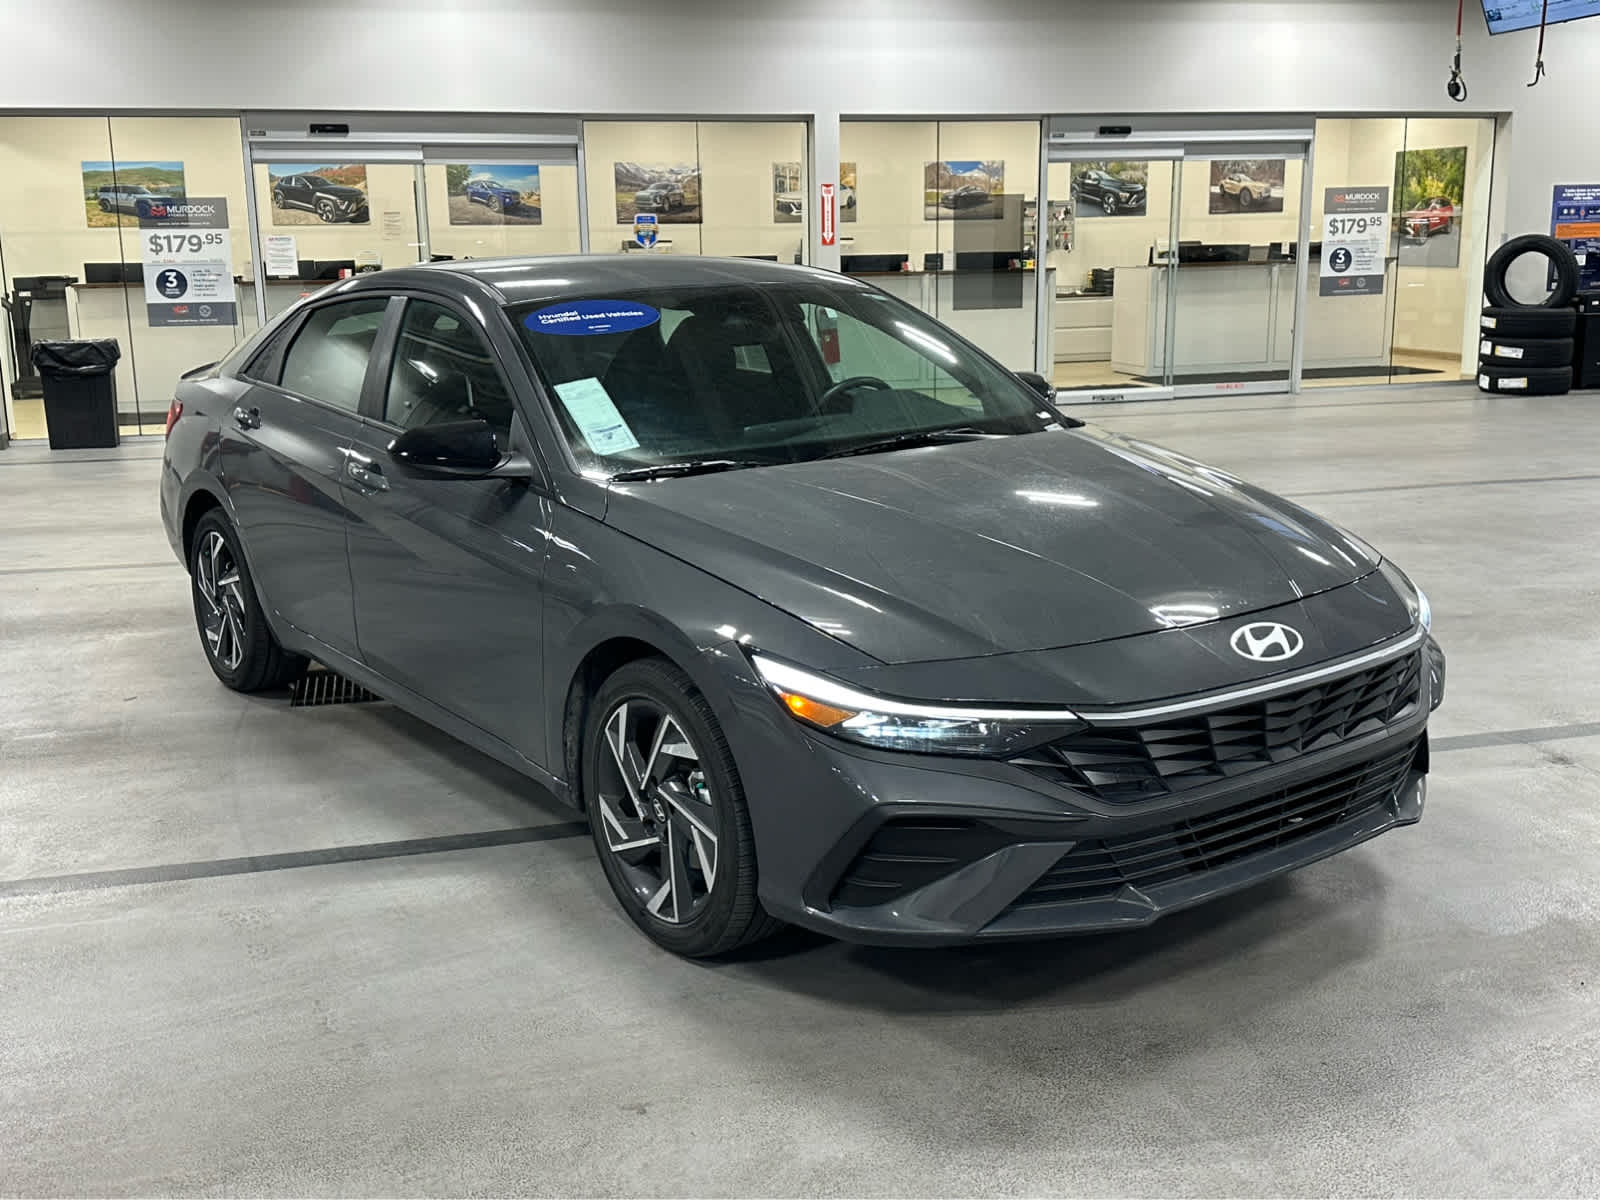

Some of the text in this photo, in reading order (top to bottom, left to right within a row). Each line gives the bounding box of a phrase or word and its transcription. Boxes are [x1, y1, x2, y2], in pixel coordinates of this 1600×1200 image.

[166, 205, 215, 213] MURDOCK
[1329, 216, 1382, 236] $179.95
[149, 233, 223, 255] $179.95
[1336, 250, 1345, 263] 3
[165, 271, 178, 287] 3
[538, 310, 579, 320] Hyundai
[541, 315, 581, 324] Certified
